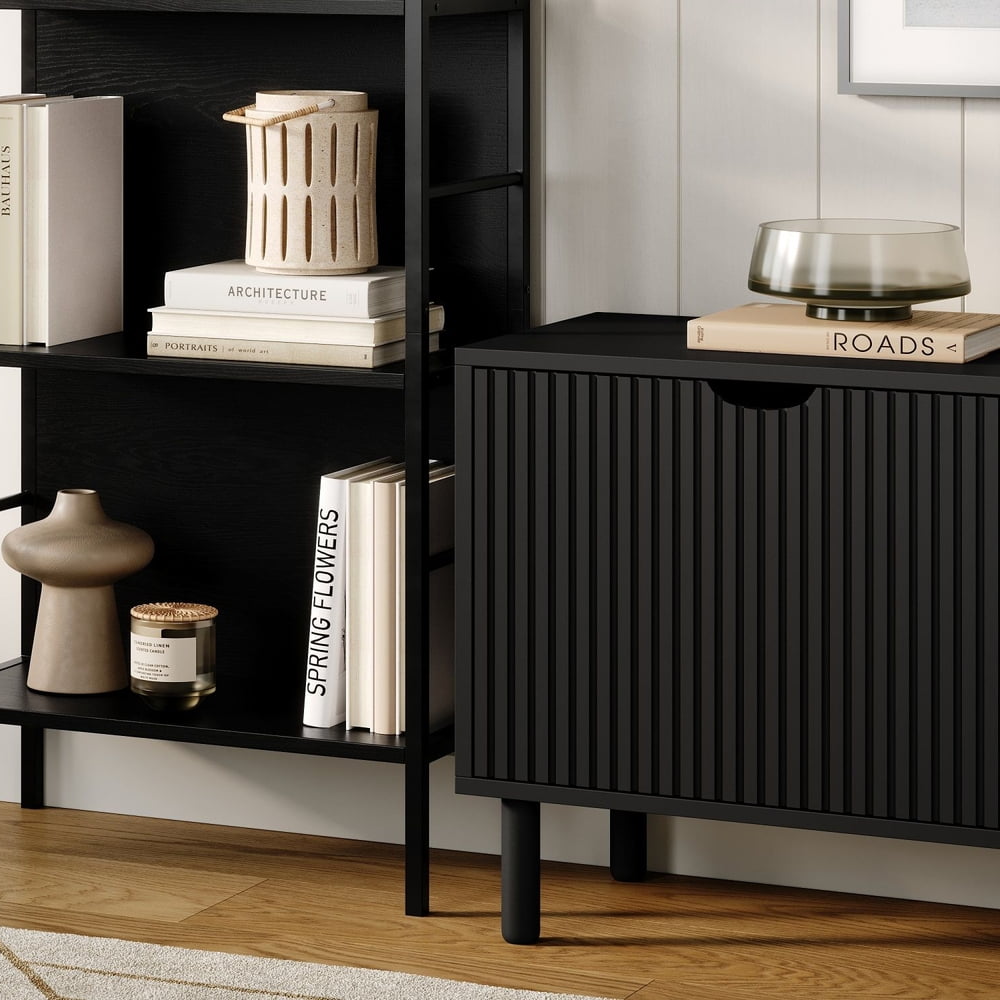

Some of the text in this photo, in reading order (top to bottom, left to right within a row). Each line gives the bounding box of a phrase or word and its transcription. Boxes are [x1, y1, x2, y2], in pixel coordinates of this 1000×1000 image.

[1, 145, 11, 216] BAUHAUS
[227, 286, 327, 302] ARCHITECTURE
[164, 341, 219, 353] PORTRAITS
[833, 332, 935, 356] ROADS
[307, 508, 339, 697] SPRING FLOWERS
